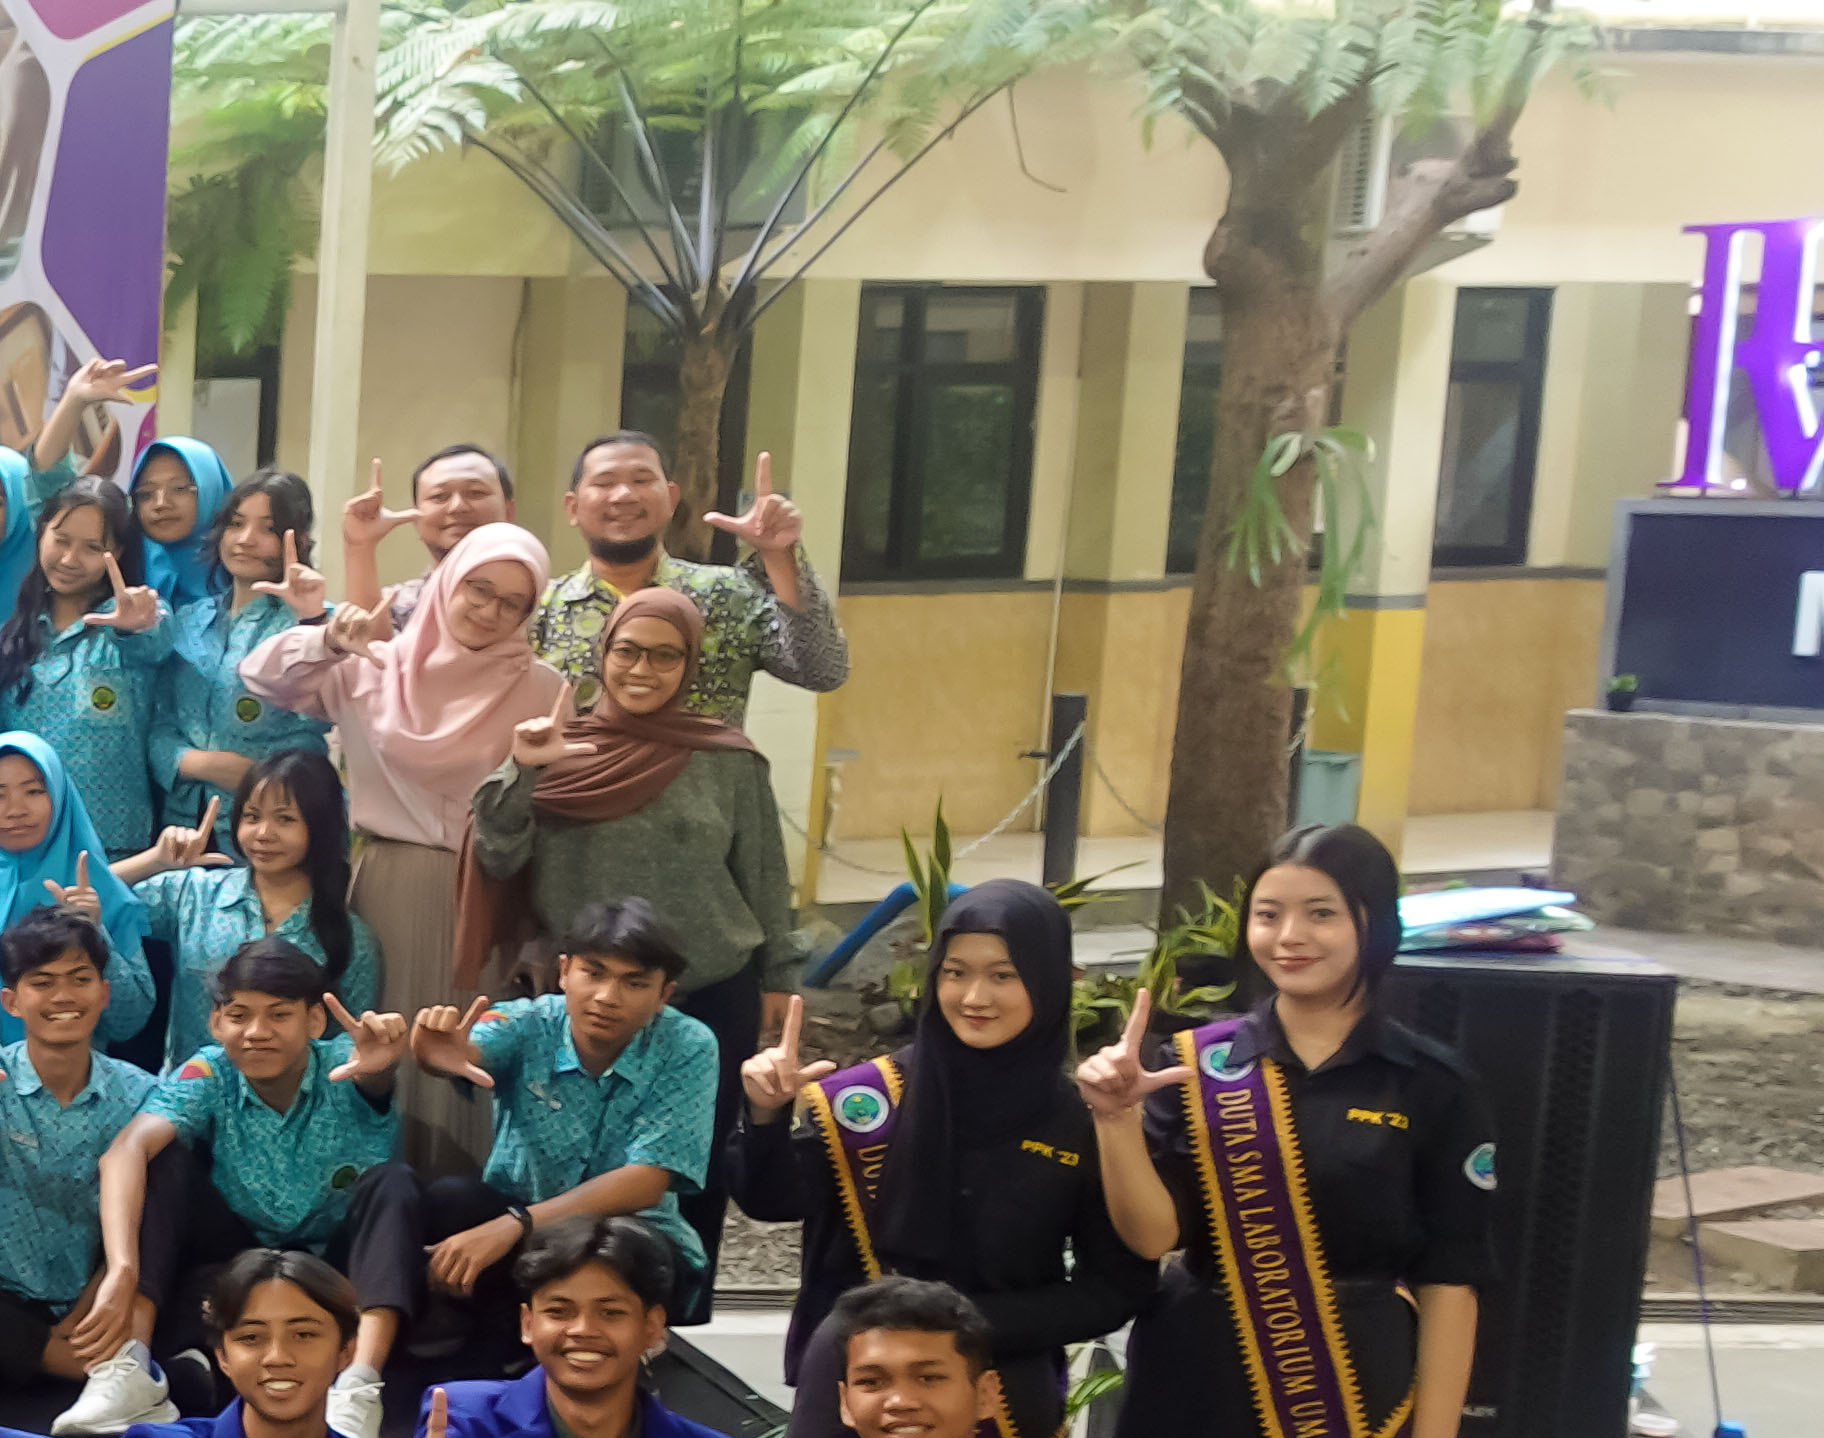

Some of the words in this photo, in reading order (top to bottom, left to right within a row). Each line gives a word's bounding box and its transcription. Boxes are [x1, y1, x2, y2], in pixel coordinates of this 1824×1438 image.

[1215, 1088, 1261, 1147] DUTA
[1021, 1139, 1054, 1158] PPK
[1225, 1153, 1266, 1203] SMA
[1237, 1206, 1319, 1397] LABORATORIUM
